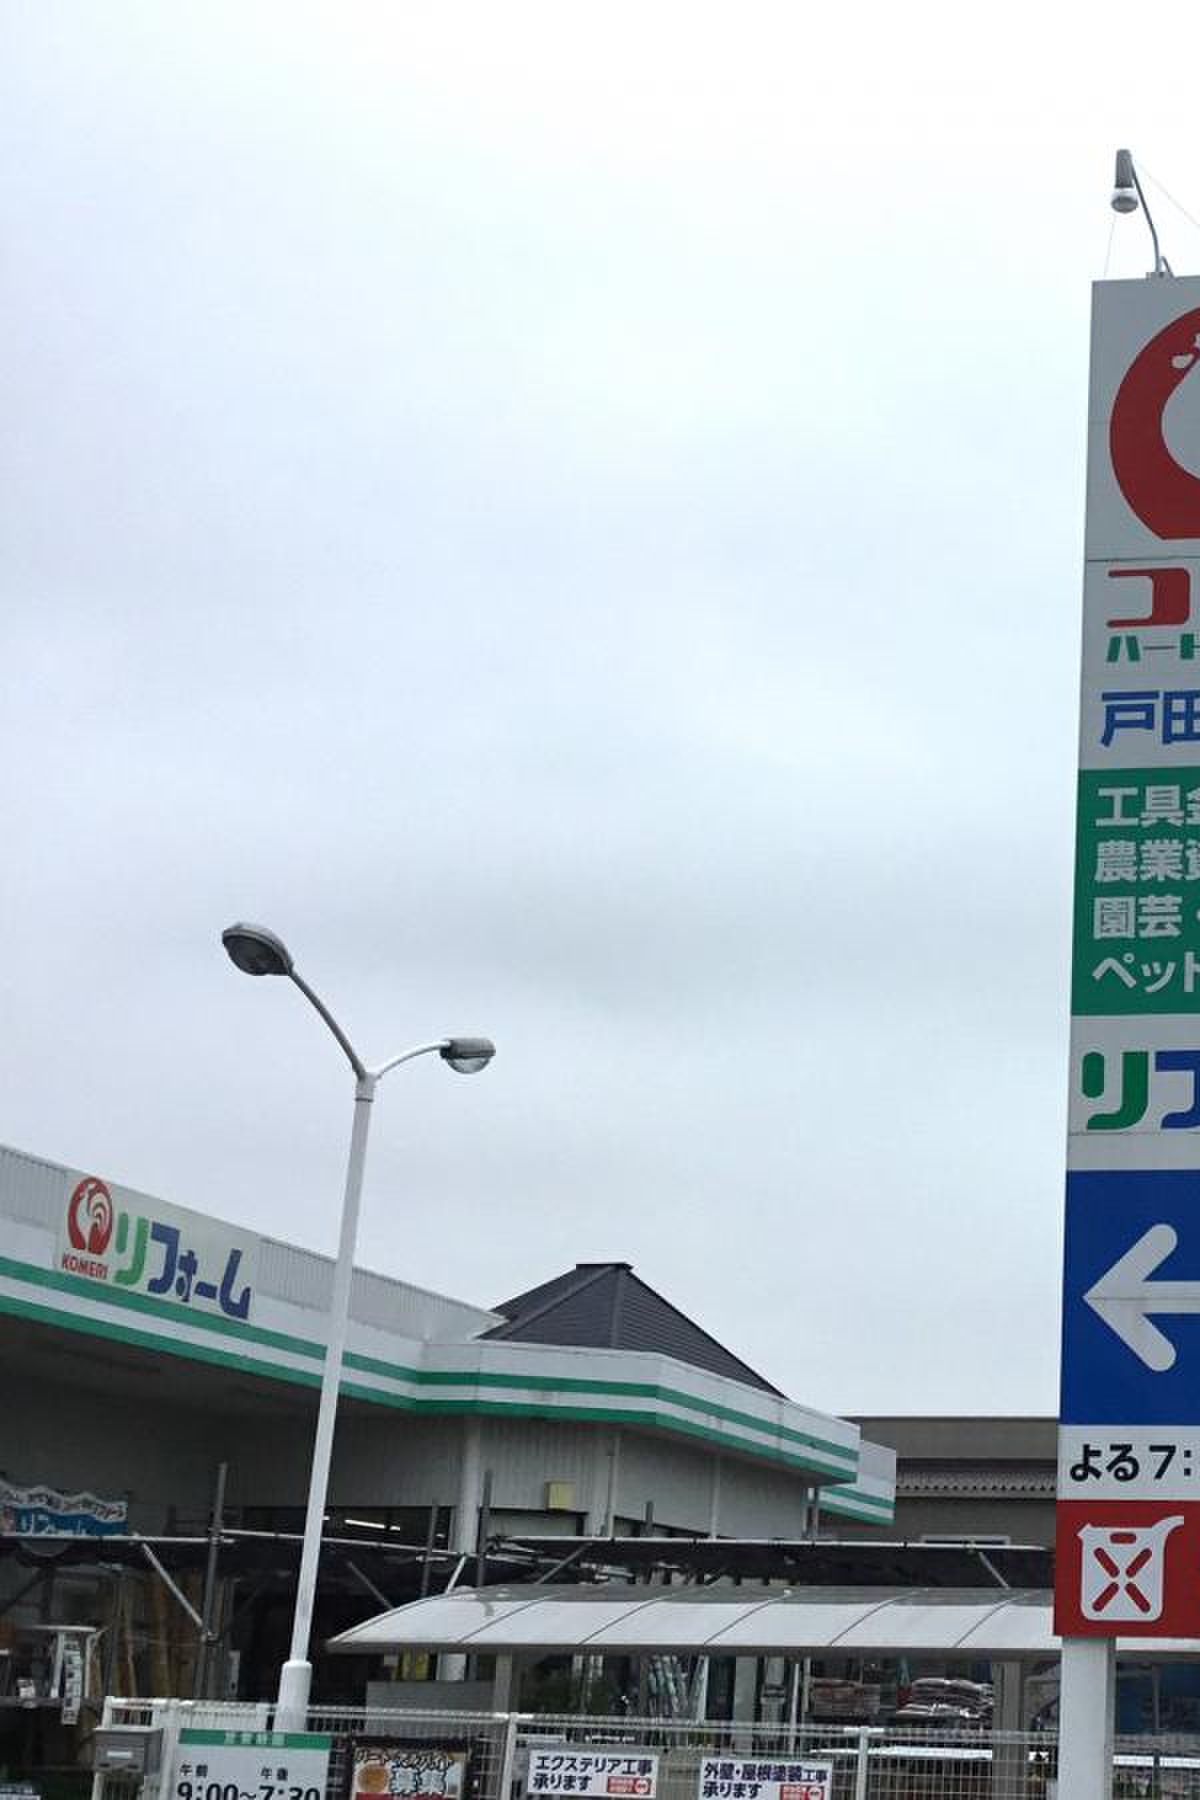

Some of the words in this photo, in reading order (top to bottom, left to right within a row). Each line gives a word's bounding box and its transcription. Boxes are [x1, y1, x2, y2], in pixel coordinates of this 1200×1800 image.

[62, 1252, 110, 1280] KOMERI
[113, 1212, 252, 1321] リフォーム
[535, 1755, 653, 1776] エクステリア工事
[532, 1772, 593, 1791] 承ります
[702, 1781, 763, 1799] 承ります
